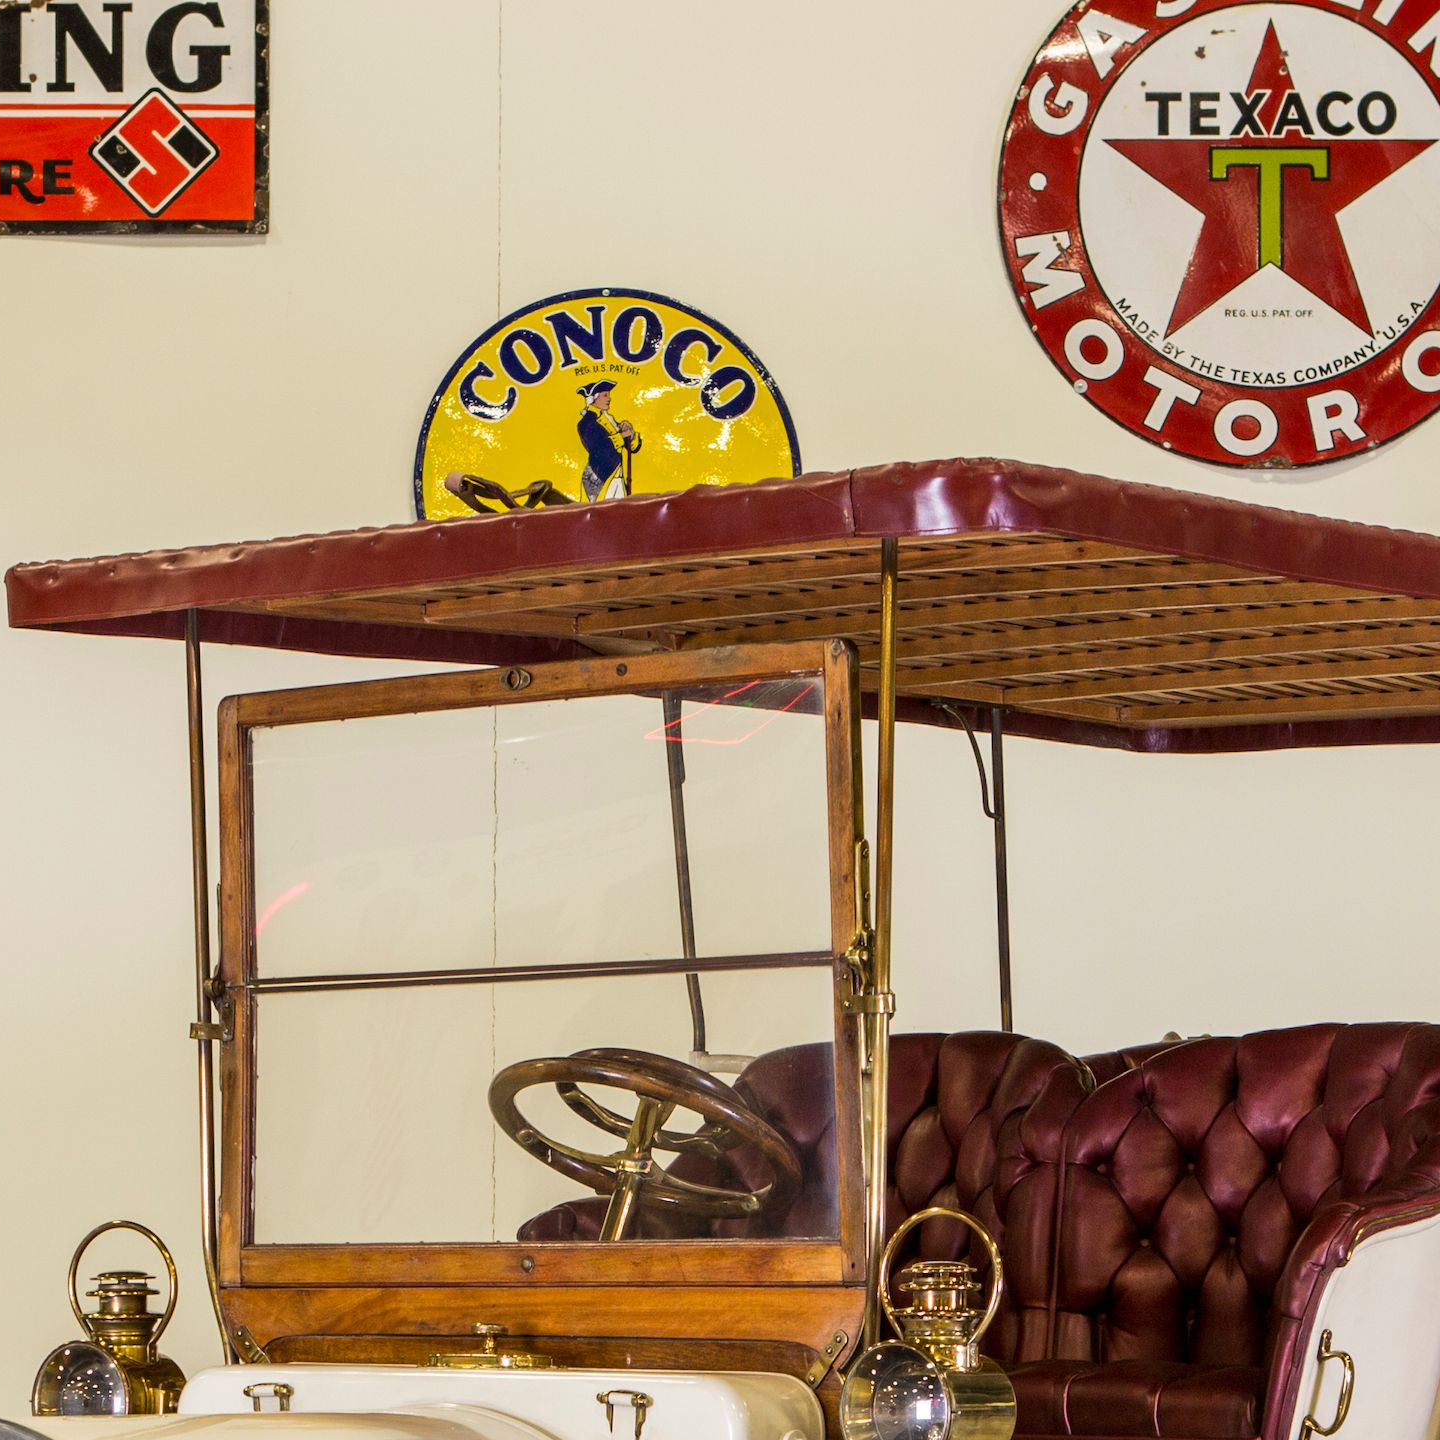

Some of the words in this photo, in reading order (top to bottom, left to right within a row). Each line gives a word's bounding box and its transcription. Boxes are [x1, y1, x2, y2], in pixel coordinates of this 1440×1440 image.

[1145, 90, 1398, 137] TEXACO
[1208, 145, 1331, 270] T
[459, 304, 757, 421] CONOCO
[1015, 230, 1368, 457] MOTOR
[1115, 297, 1160, 343] MADE
[1162, 341, 1185, 359] BY
[1190, 355, 1225, 379] THE
[1230, 368, 1286, 384] TEXAS
[1382, 299, 1426, 340] U.S.A.
